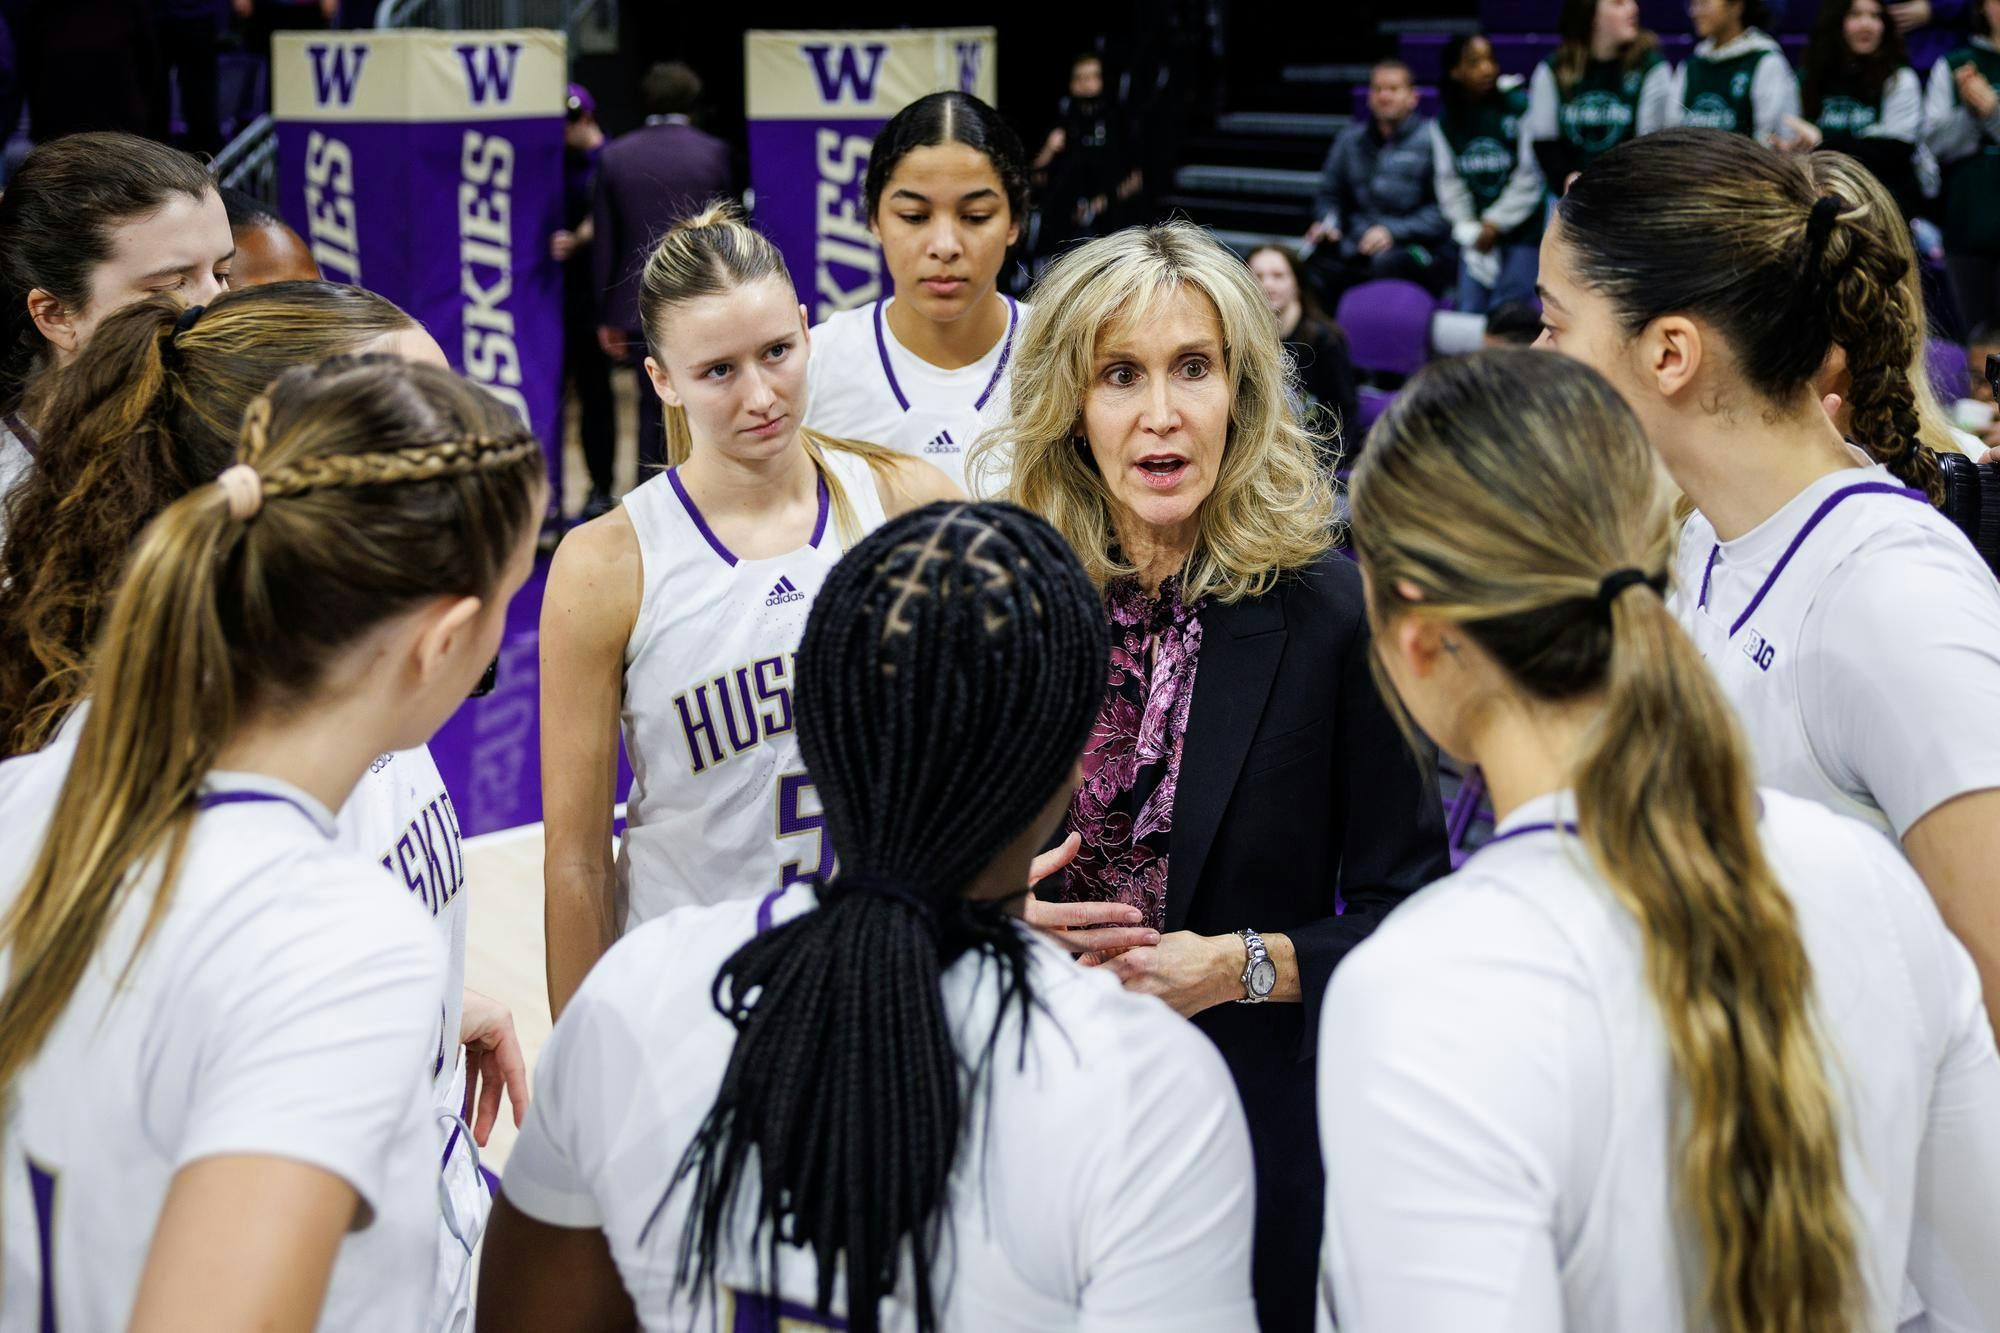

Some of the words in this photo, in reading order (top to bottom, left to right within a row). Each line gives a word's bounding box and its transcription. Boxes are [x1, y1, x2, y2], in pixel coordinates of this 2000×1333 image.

[308, 44, 368, 106] W
[456, 43, 521, 105] W
[804, 43, 884, 104] W
[305, 130, 361, 286] IES
[765, 591, 805, 607] adidas
[672, 650, 799, 775] HUS
[775, 771, 838, 888] 5
